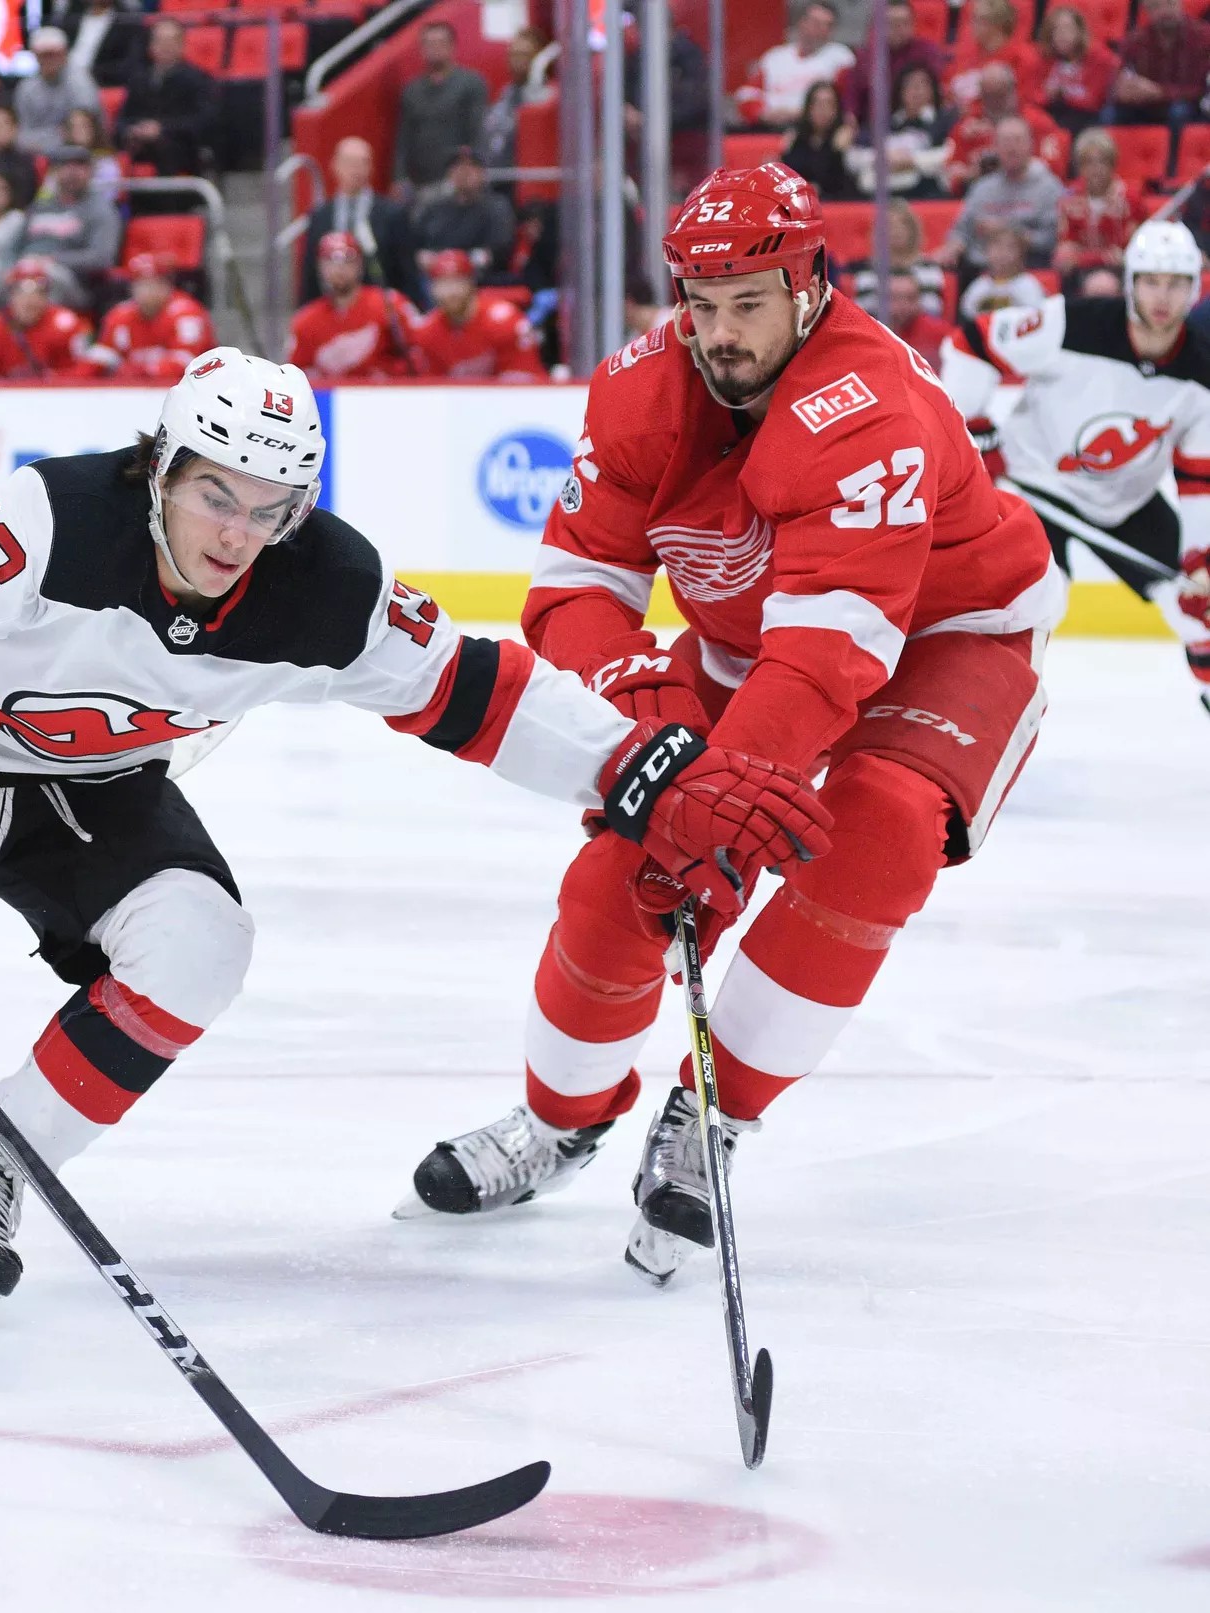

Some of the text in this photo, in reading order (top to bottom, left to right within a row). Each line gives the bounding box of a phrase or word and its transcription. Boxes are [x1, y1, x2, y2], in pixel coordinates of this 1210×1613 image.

[696, 201, 734, 223] 52
[690, 242, 733, 255] CCM
[262, 388, 294, 416] 13
[245, 431, 297, 453] CCM
[830, 446, 928, 530] 52
[587, 653, 673, 696] CM
[864, 704, 978, 747] CCM
[615, 742, 642, 775] HISCHIER
[618, 727, 694, 817] CCM
[644, 872, 685, 890] CCM
